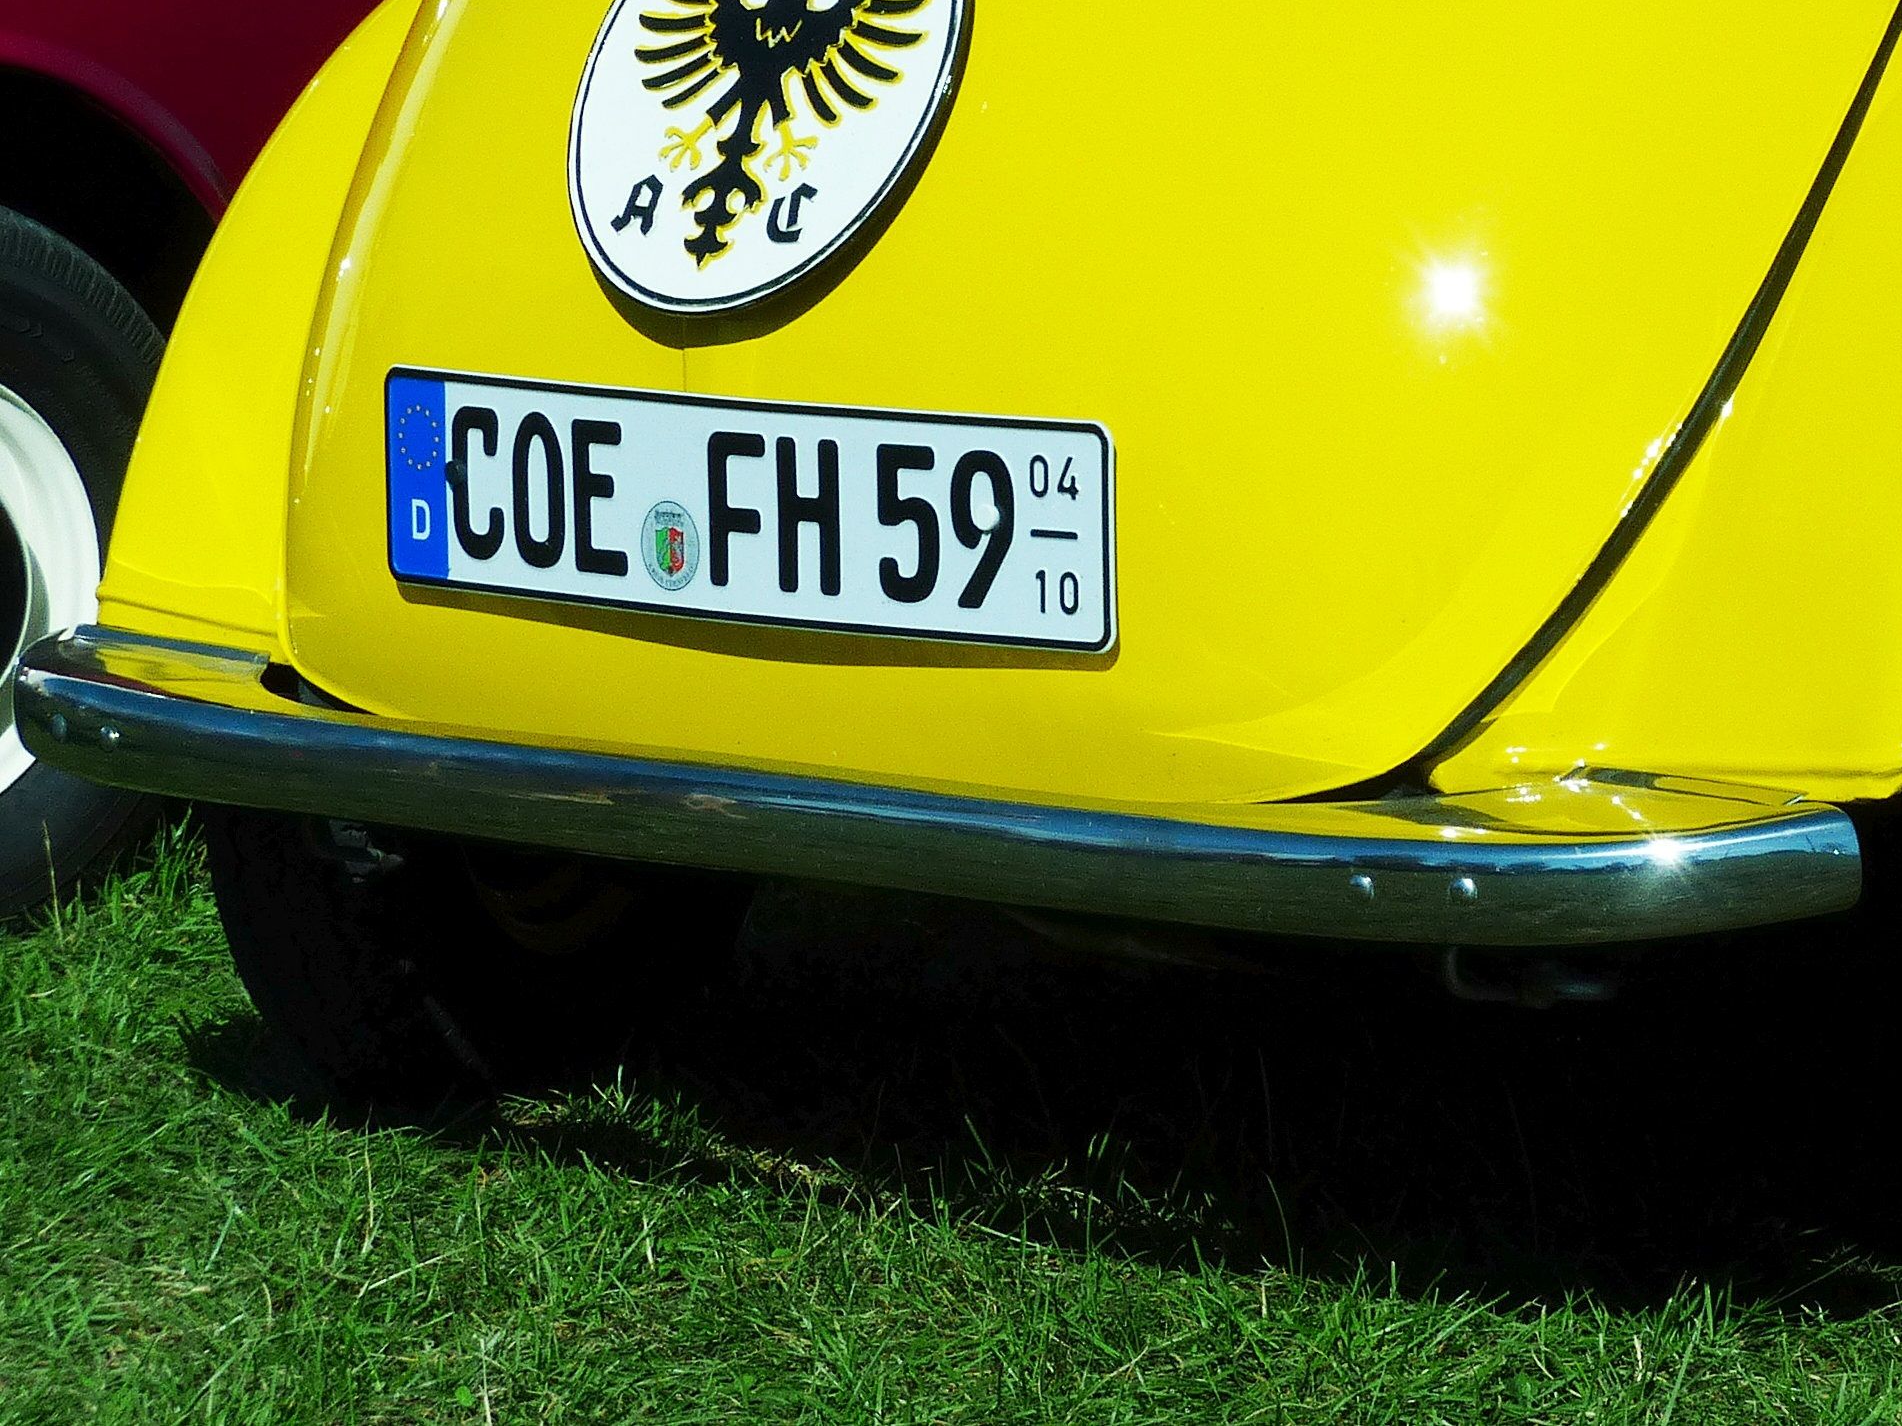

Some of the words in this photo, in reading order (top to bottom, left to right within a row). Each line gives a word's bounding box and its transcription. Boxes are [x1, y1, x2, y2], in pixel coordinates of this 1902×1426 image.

[1029, 454, 1079, 501] 04
[411, 498, 431, 541] D
[450, 405, 629, 577] COE
[707, 431, 841, 597] FH
[876, 443, 1015, 609] 59
[1035, 569, 1079, 616] 10
